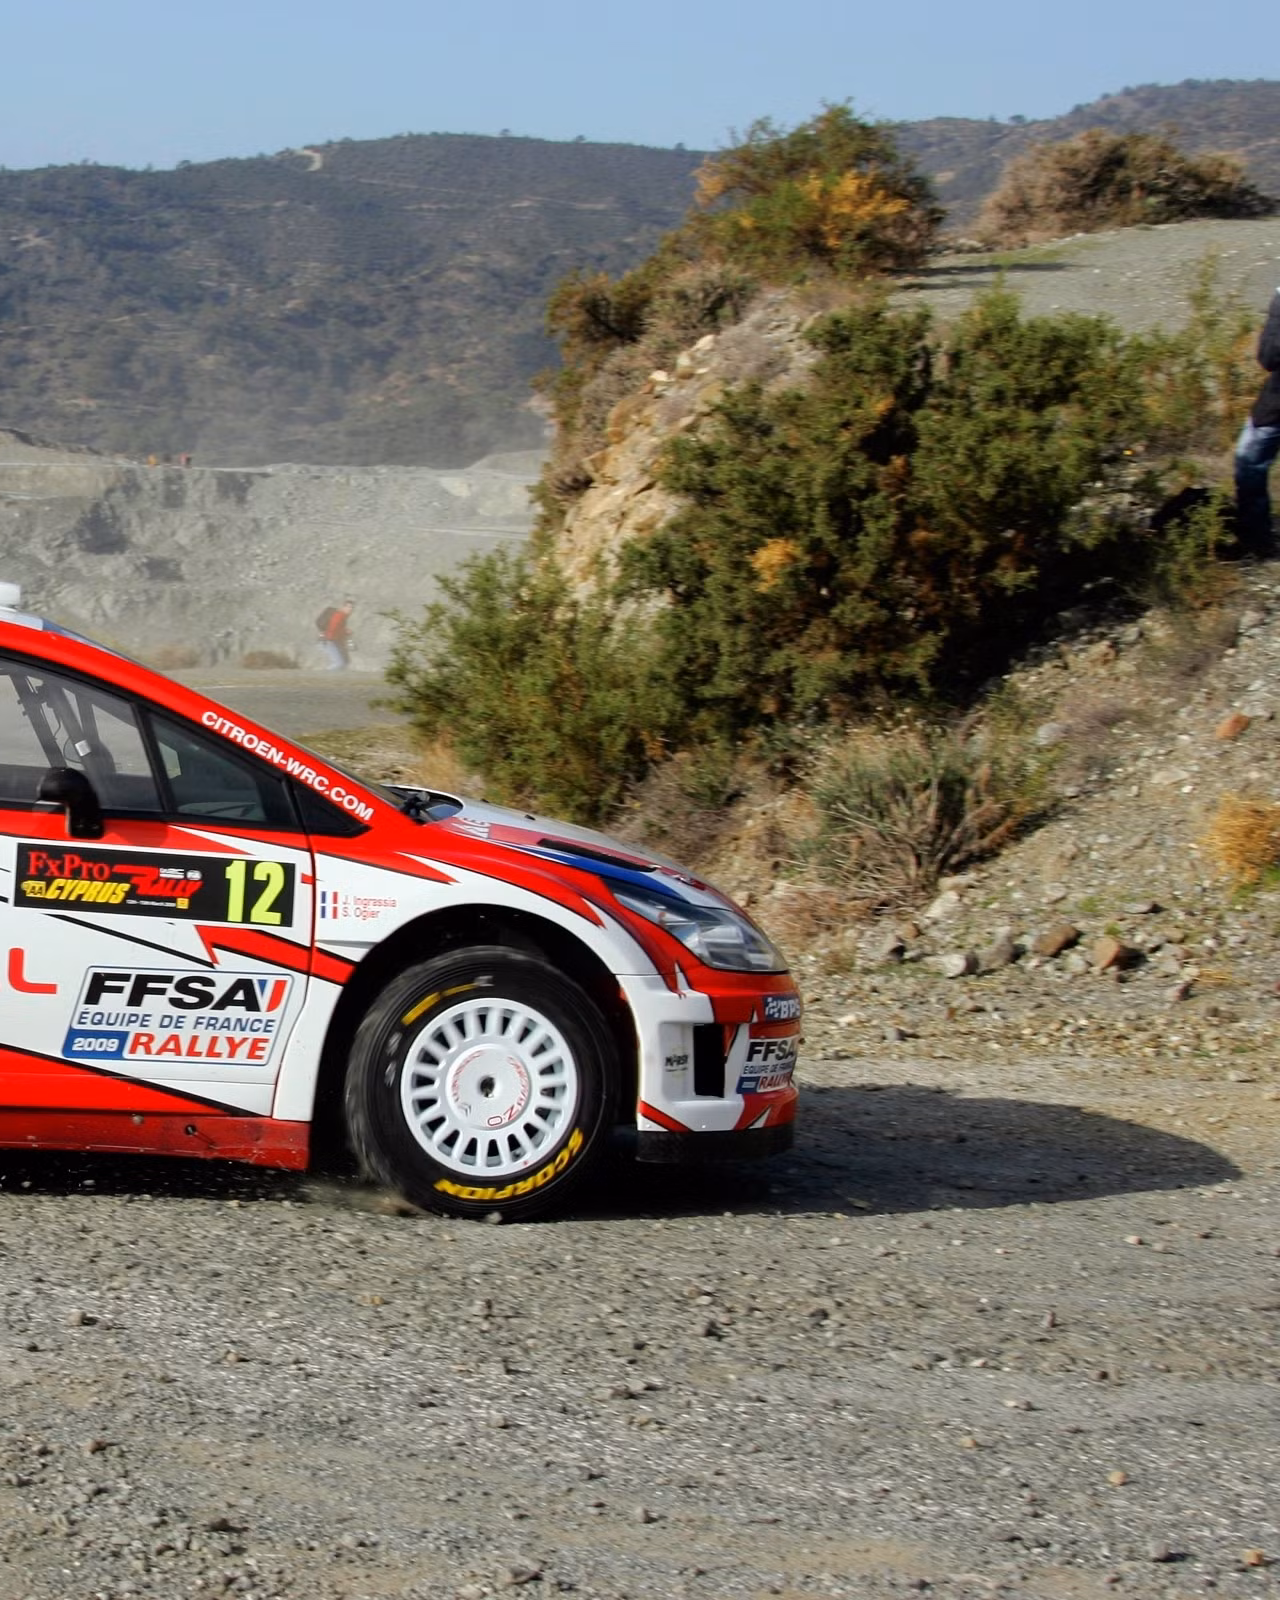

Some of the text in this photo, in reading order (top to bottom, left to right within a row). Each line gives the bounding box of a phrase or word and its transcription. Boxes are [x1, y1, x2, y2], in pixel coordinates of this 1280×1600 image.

[201, 710, 375, 821] CITROEN-WRC.COM
[27, 851, 111, 881] FxPro
[46, 879, 131, 904] CYPRUS
[224, 860, 285, 925] 12
[354, 907, 381, 920] Ogier
[84, 972, 261, 1012] FFSA
[77, 1008, 276, 1033] ÉQUIPE DE FRANCE
[72, 1032, 270, 1060] 2009 RALLYE
[433, 1127, 585, 1200] SCORPION
